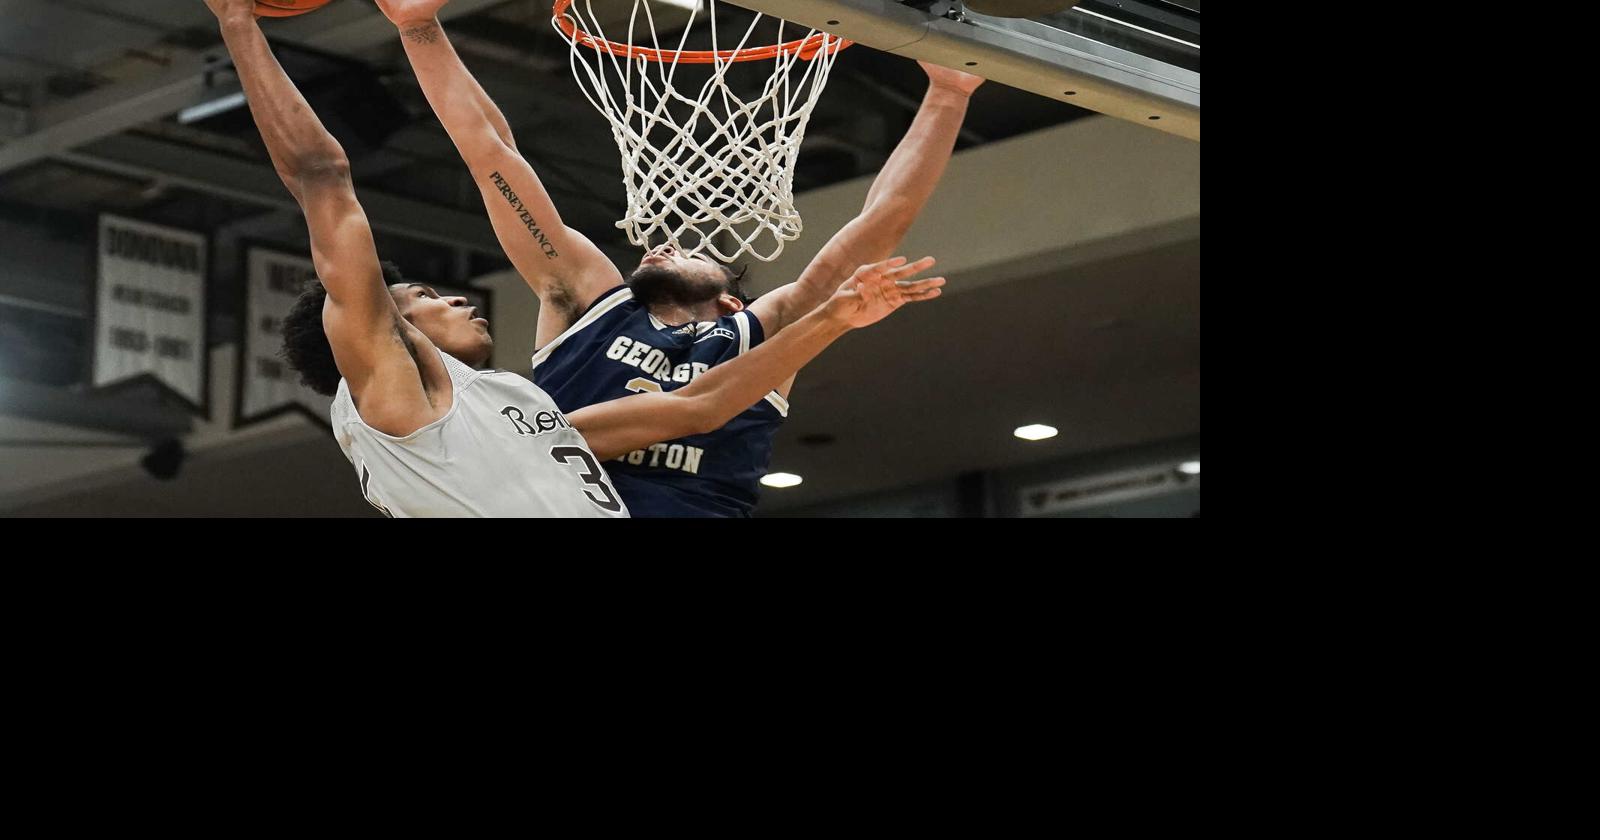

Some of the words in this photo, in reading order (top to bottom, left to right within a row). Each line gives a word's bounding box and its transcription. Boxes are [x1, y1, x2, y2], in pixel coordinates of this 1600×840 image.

[489, 171, 559, 260] PERSEVERANCE
[606, 335, 709, 385] GEORGE
[549, 445, 622, 513] 3
[617, 443, 705, 475] GTON
